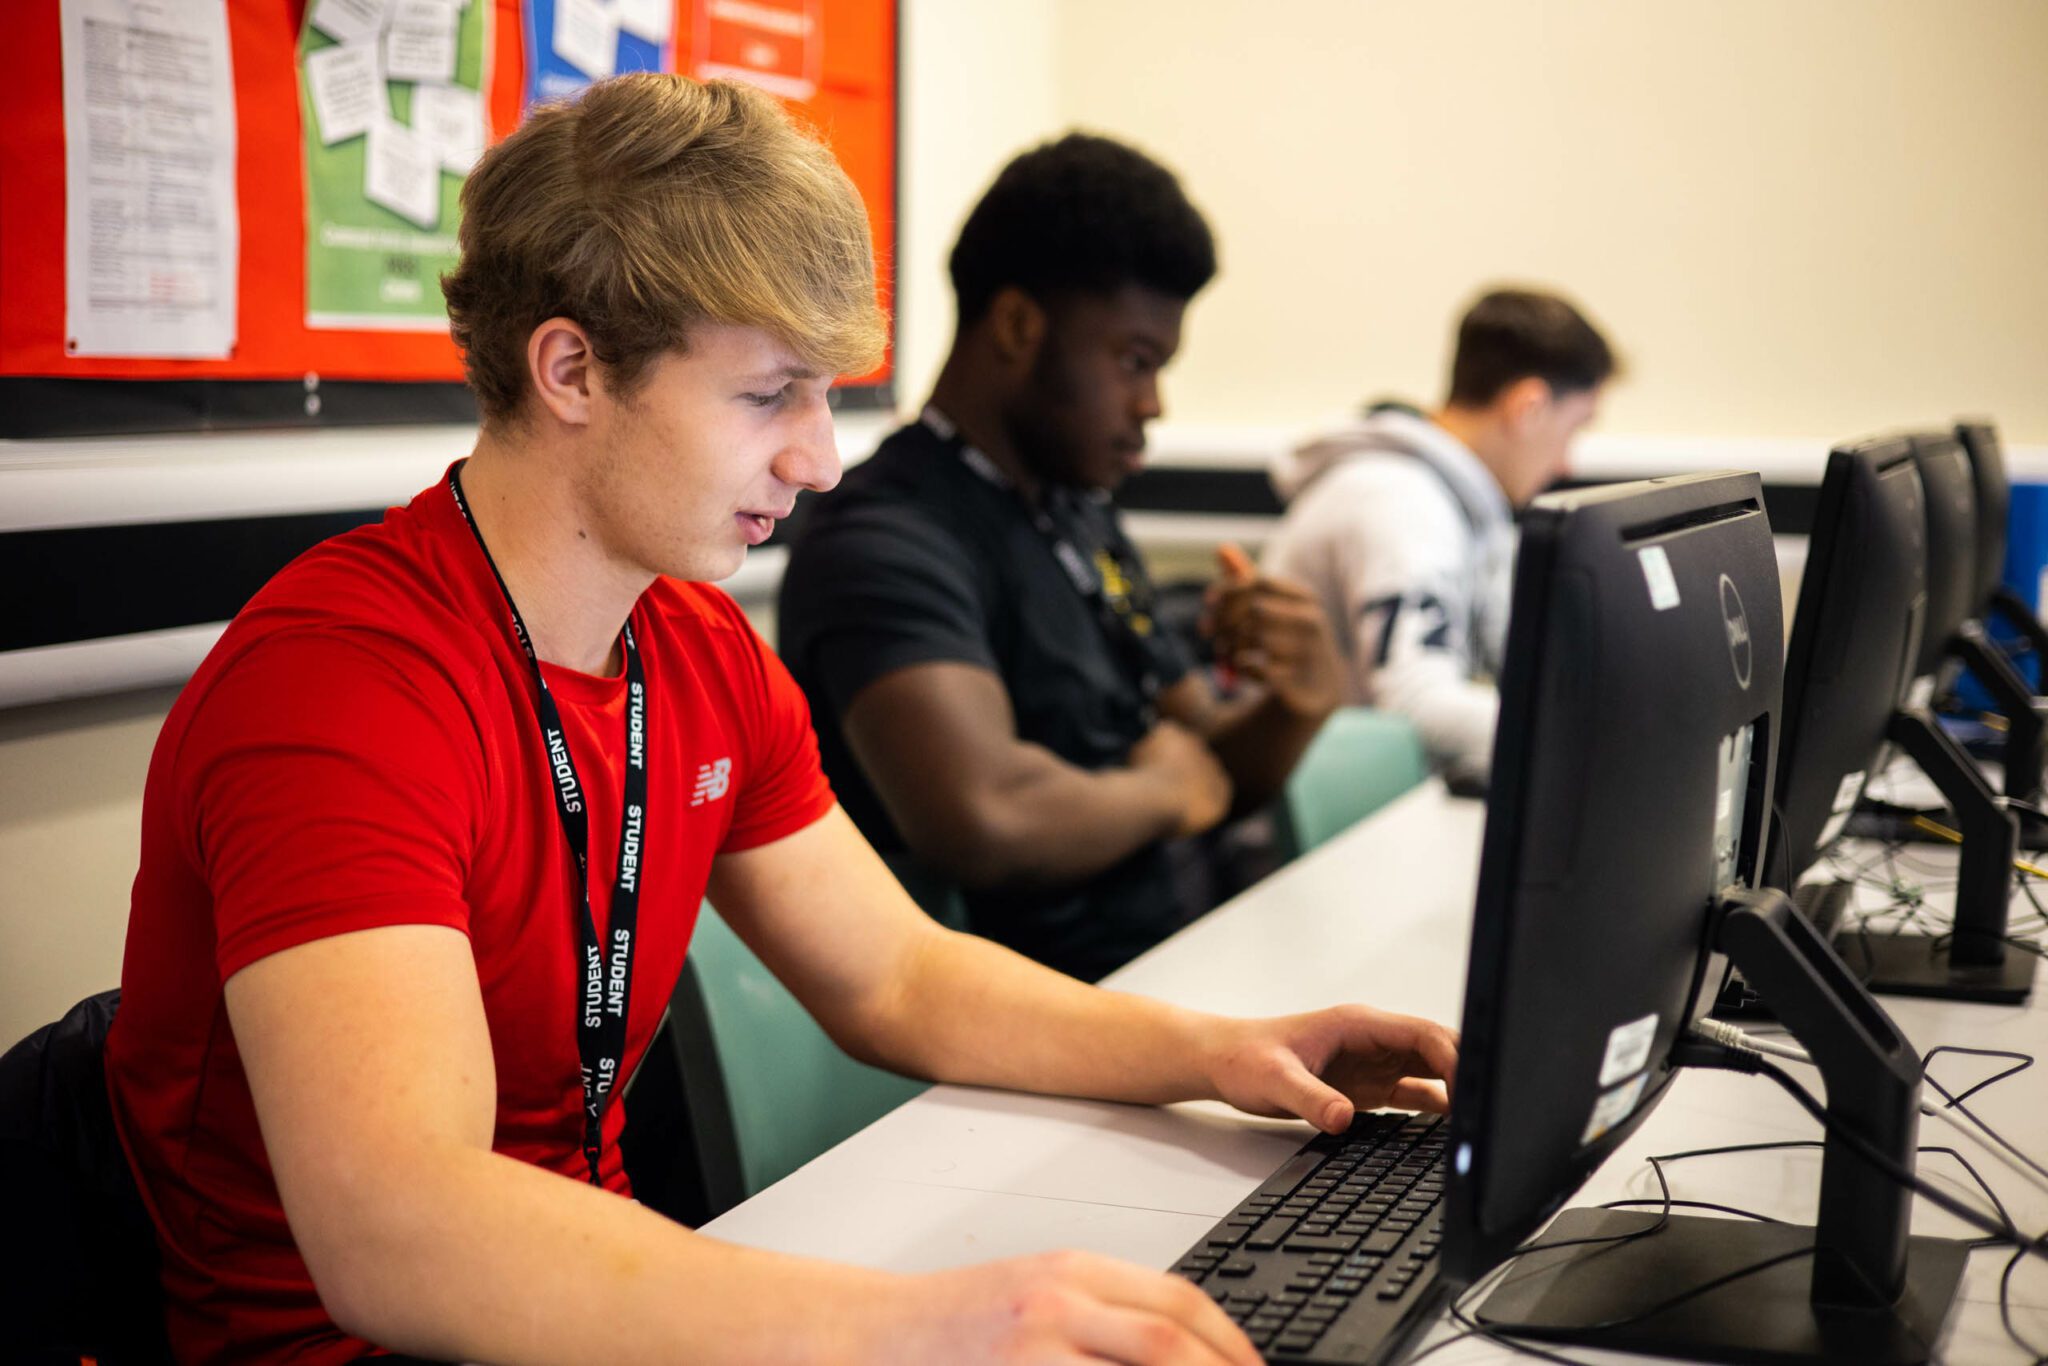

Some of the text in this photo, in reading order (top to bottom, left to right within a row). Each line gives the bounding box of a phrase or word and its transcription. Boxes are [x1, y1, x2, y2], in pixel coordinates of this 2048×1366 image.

[630, 682, 643, 770] STUDENT
[547, 728, 582, 813] STUDENT
[620, 804, 642, 893] STUDENT
[585, 945, 603, 1028] STUDENT
[607, 929, 630, 1017] STUDENT
